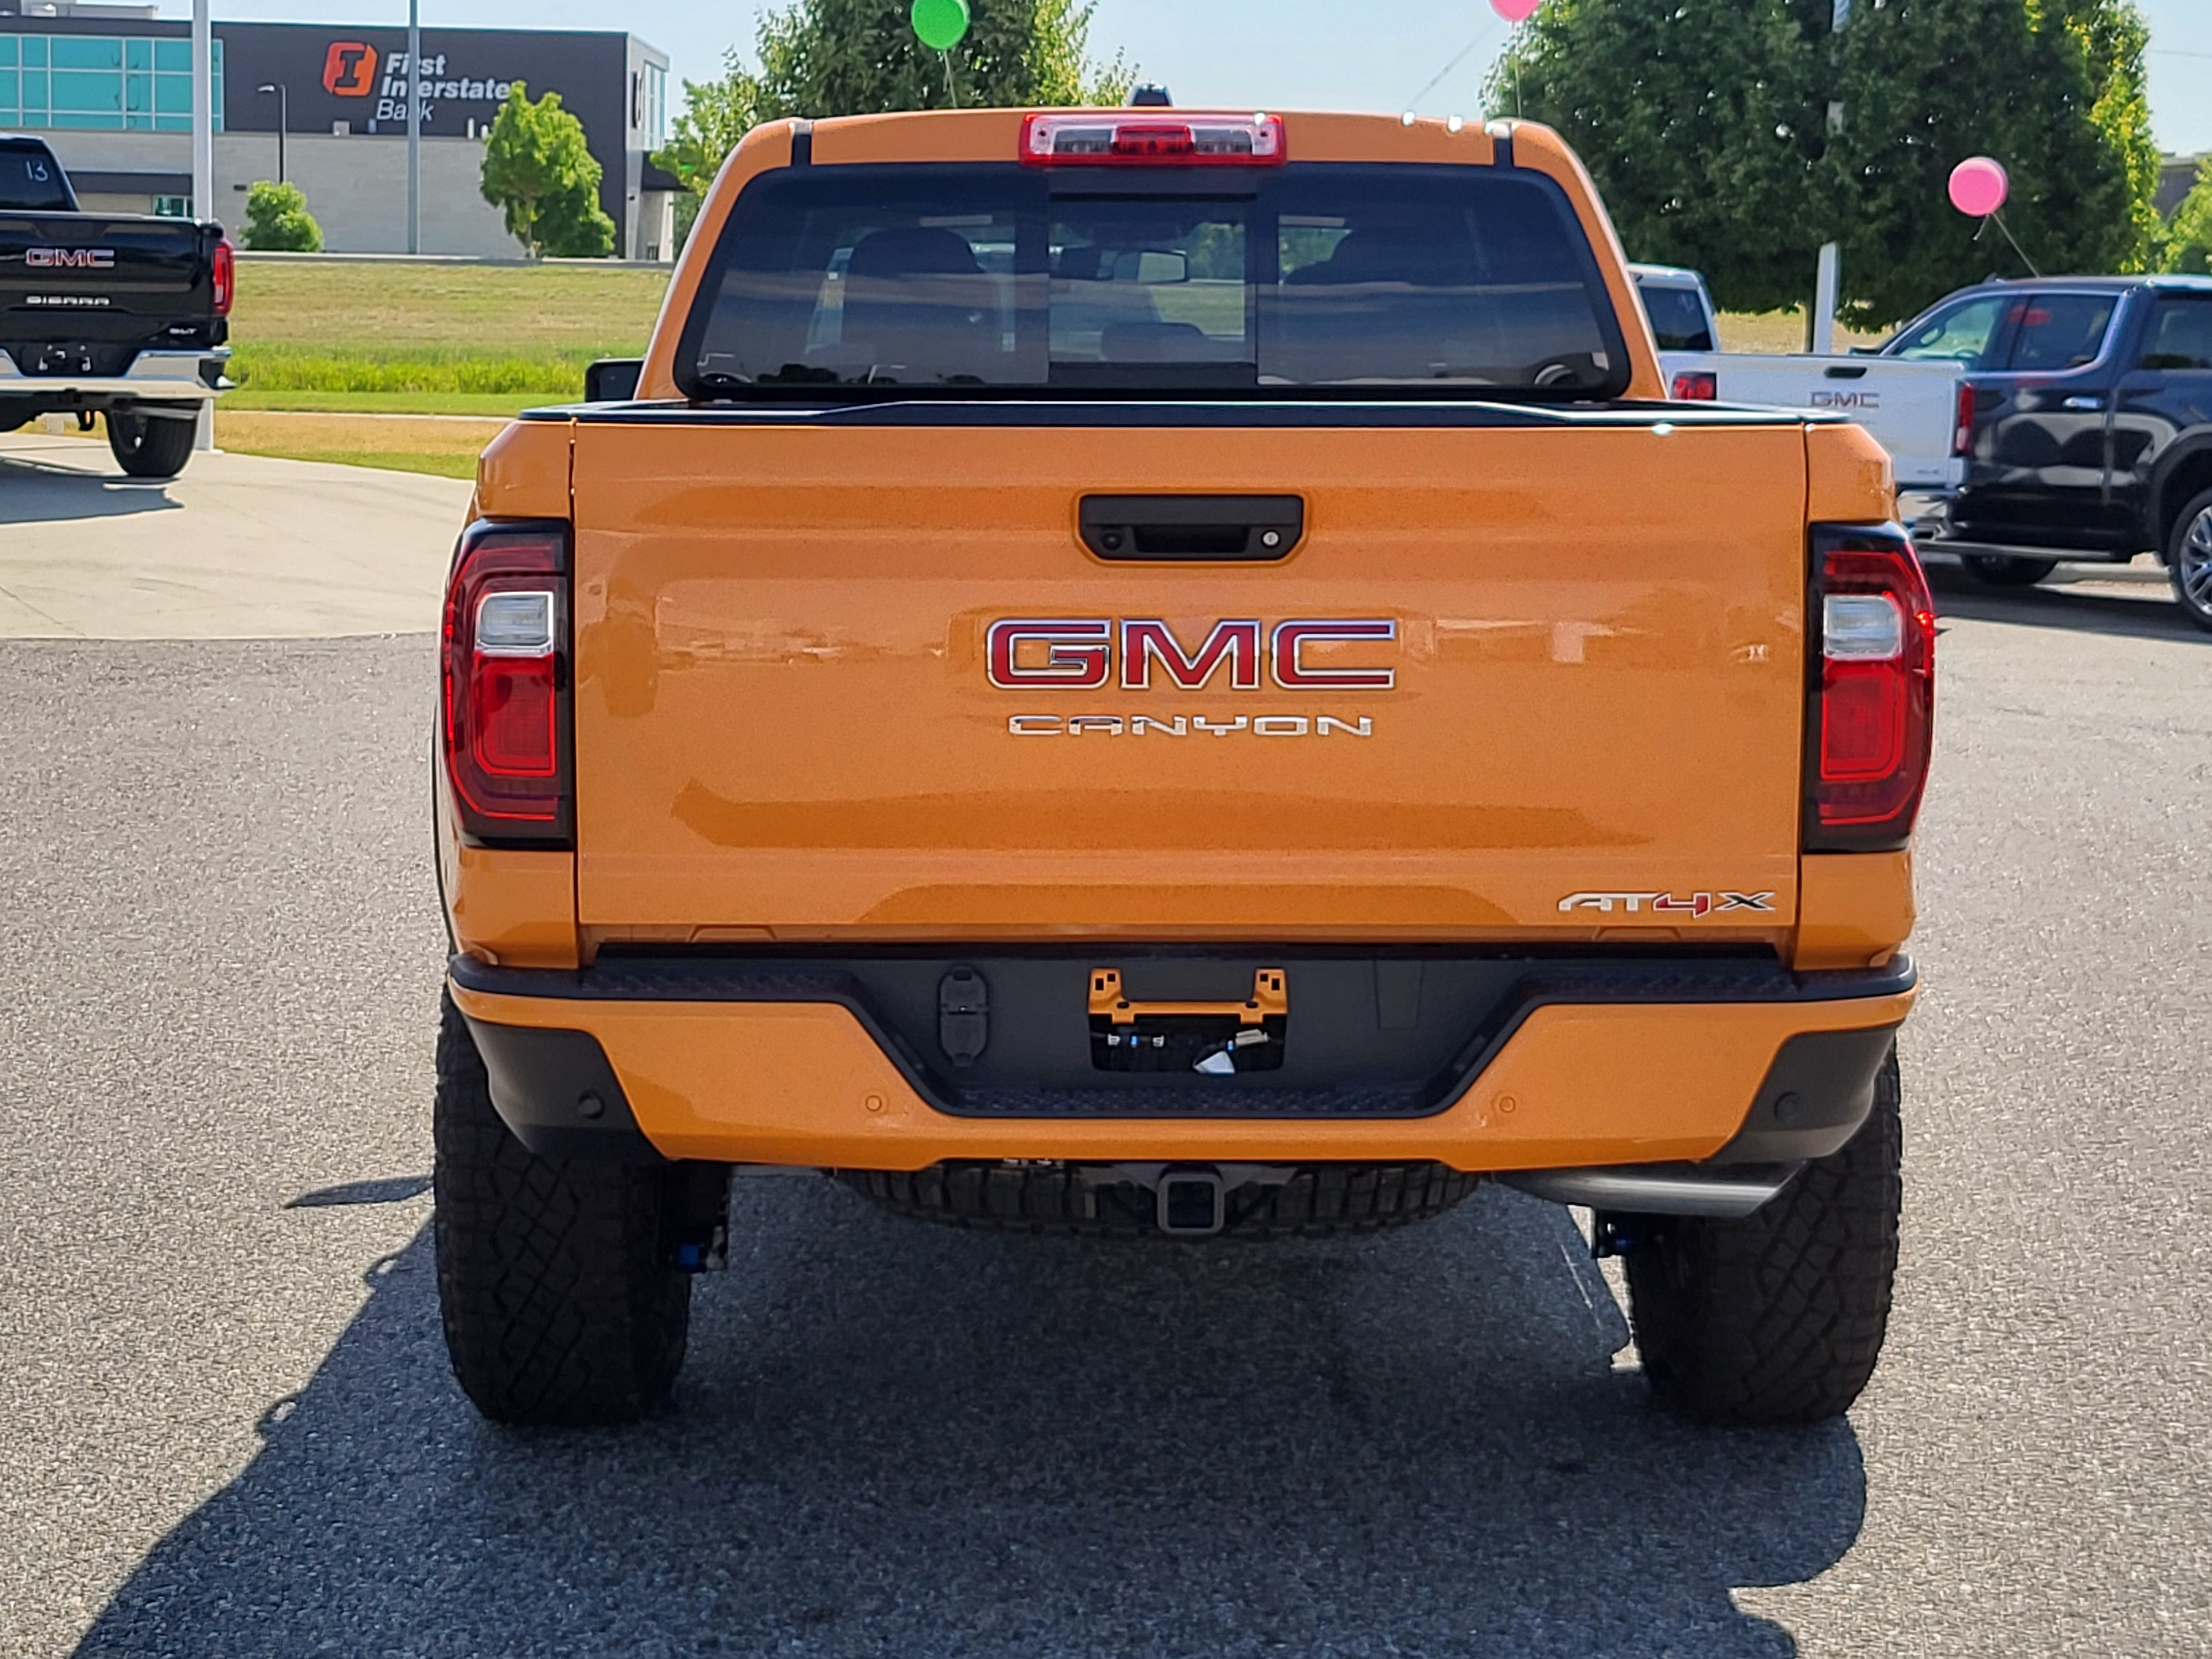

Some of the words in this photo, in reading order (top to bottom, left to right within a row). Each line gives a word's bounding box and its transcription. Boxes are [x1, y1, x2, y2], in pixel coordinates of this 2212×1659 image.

[386, 53, 446, 75] Fist
[381, 76, 511, 100] Inerstate
[377, 98, 434, 121] Bak
[26, 248, 114, 267] GMC
[27, 295, 109, 306] SIERRA
[1811, 392, 1880, 408] GMC
[987, 618, 1396, 690] GMC
[1009, 714, 1373, 737] CANYON
[1558, 891, 1776, 919] AT4X
